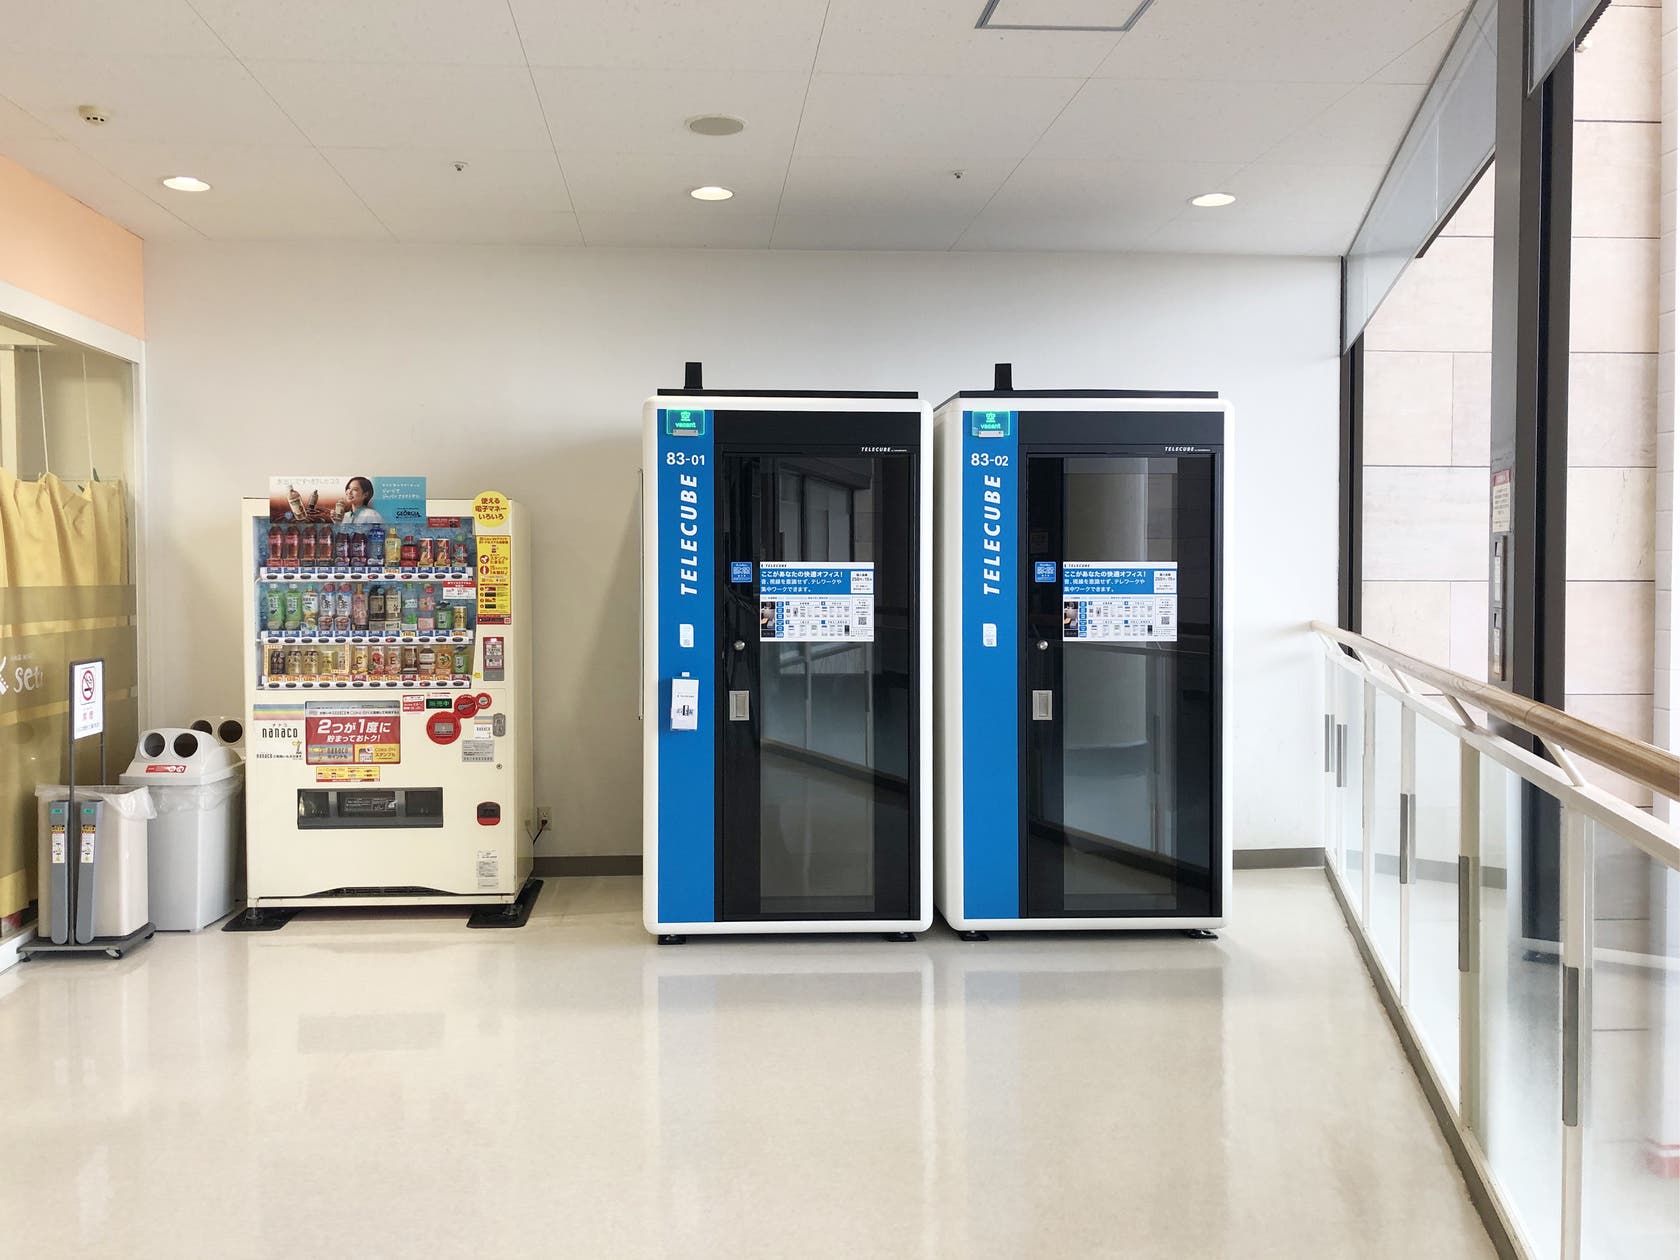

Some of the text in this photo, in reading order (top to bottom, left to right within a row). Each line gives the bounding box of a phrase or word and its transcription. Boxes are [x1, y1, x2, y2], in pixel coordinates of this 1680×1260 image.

[985, 413, 996, 423] 空
[666, 452, 705, 466] 83-01
[971, 452, 1009, 467] 83-02
[480, 497, 501, 505] 使える
[475, 505, 507, 513] 電子マネー
[478, 512, 504, 520] いろいろ
[680, 474, 698, 596] TELECUBE
[983, 474, 1001, 596] TELECUBE
[317, 718, 392, 734] 2つが1度に
[262, 727, 298, 738] nanaco
[326, 735, 381, 743] 貯まっておトク!
